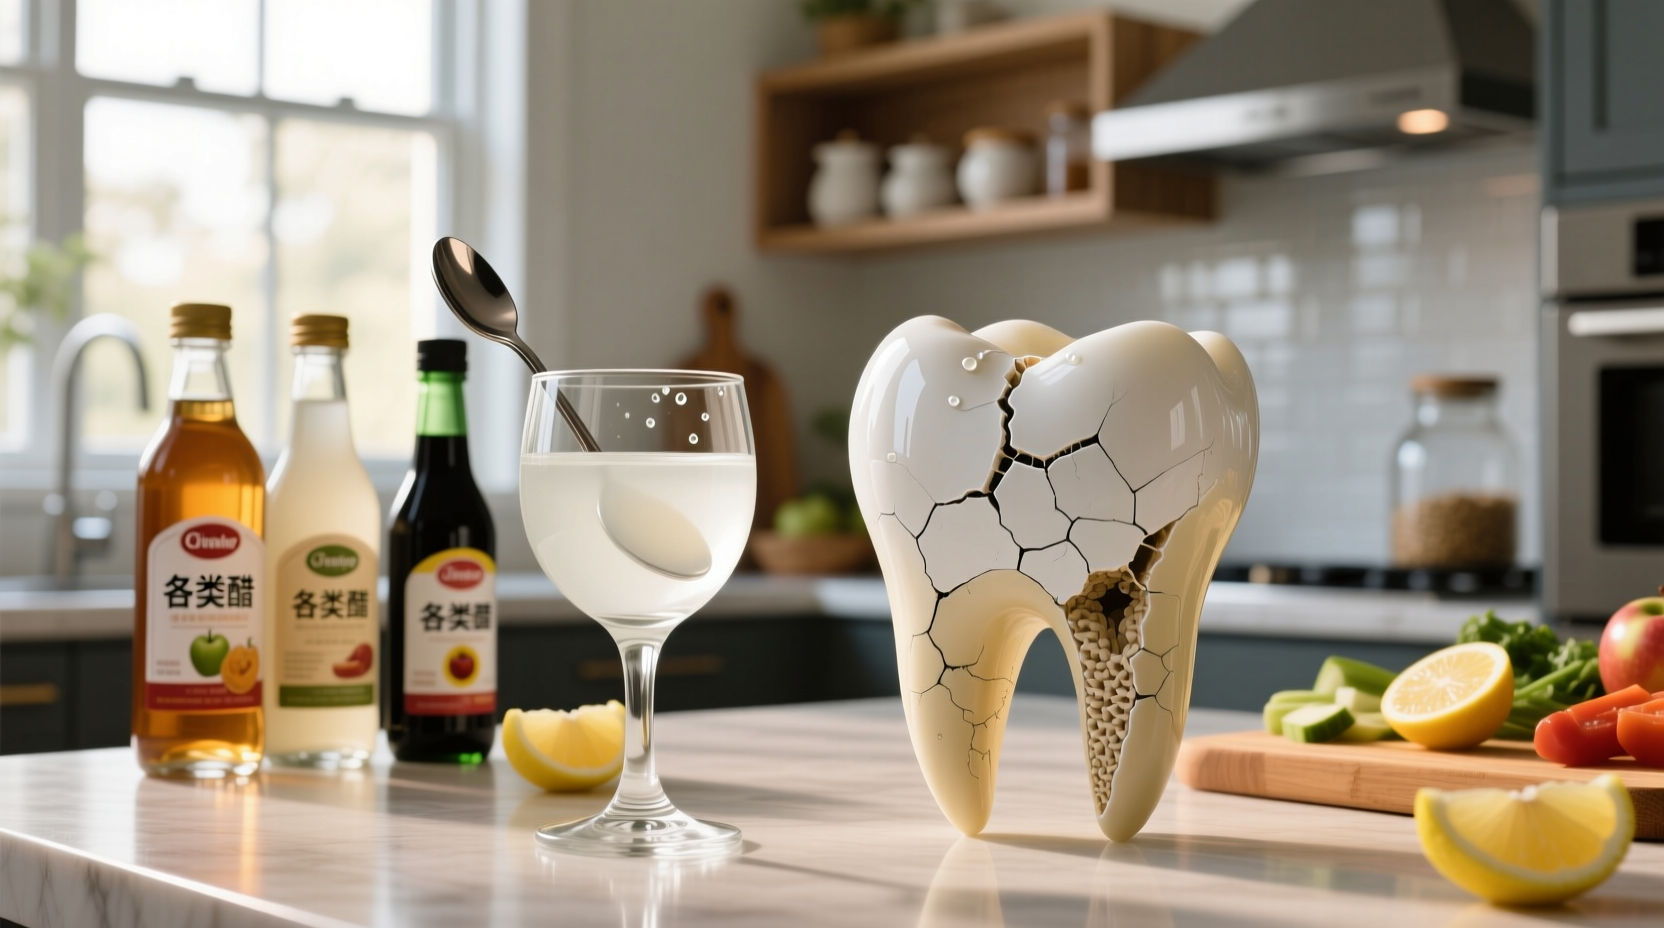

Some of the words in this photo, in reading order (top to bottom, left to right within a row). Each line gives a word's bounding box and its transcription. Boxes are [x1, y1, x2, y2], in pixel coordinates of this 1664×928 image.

[164, 574, 255, 609] 各类醋
[292, 589, 369, 619] 各类醋
